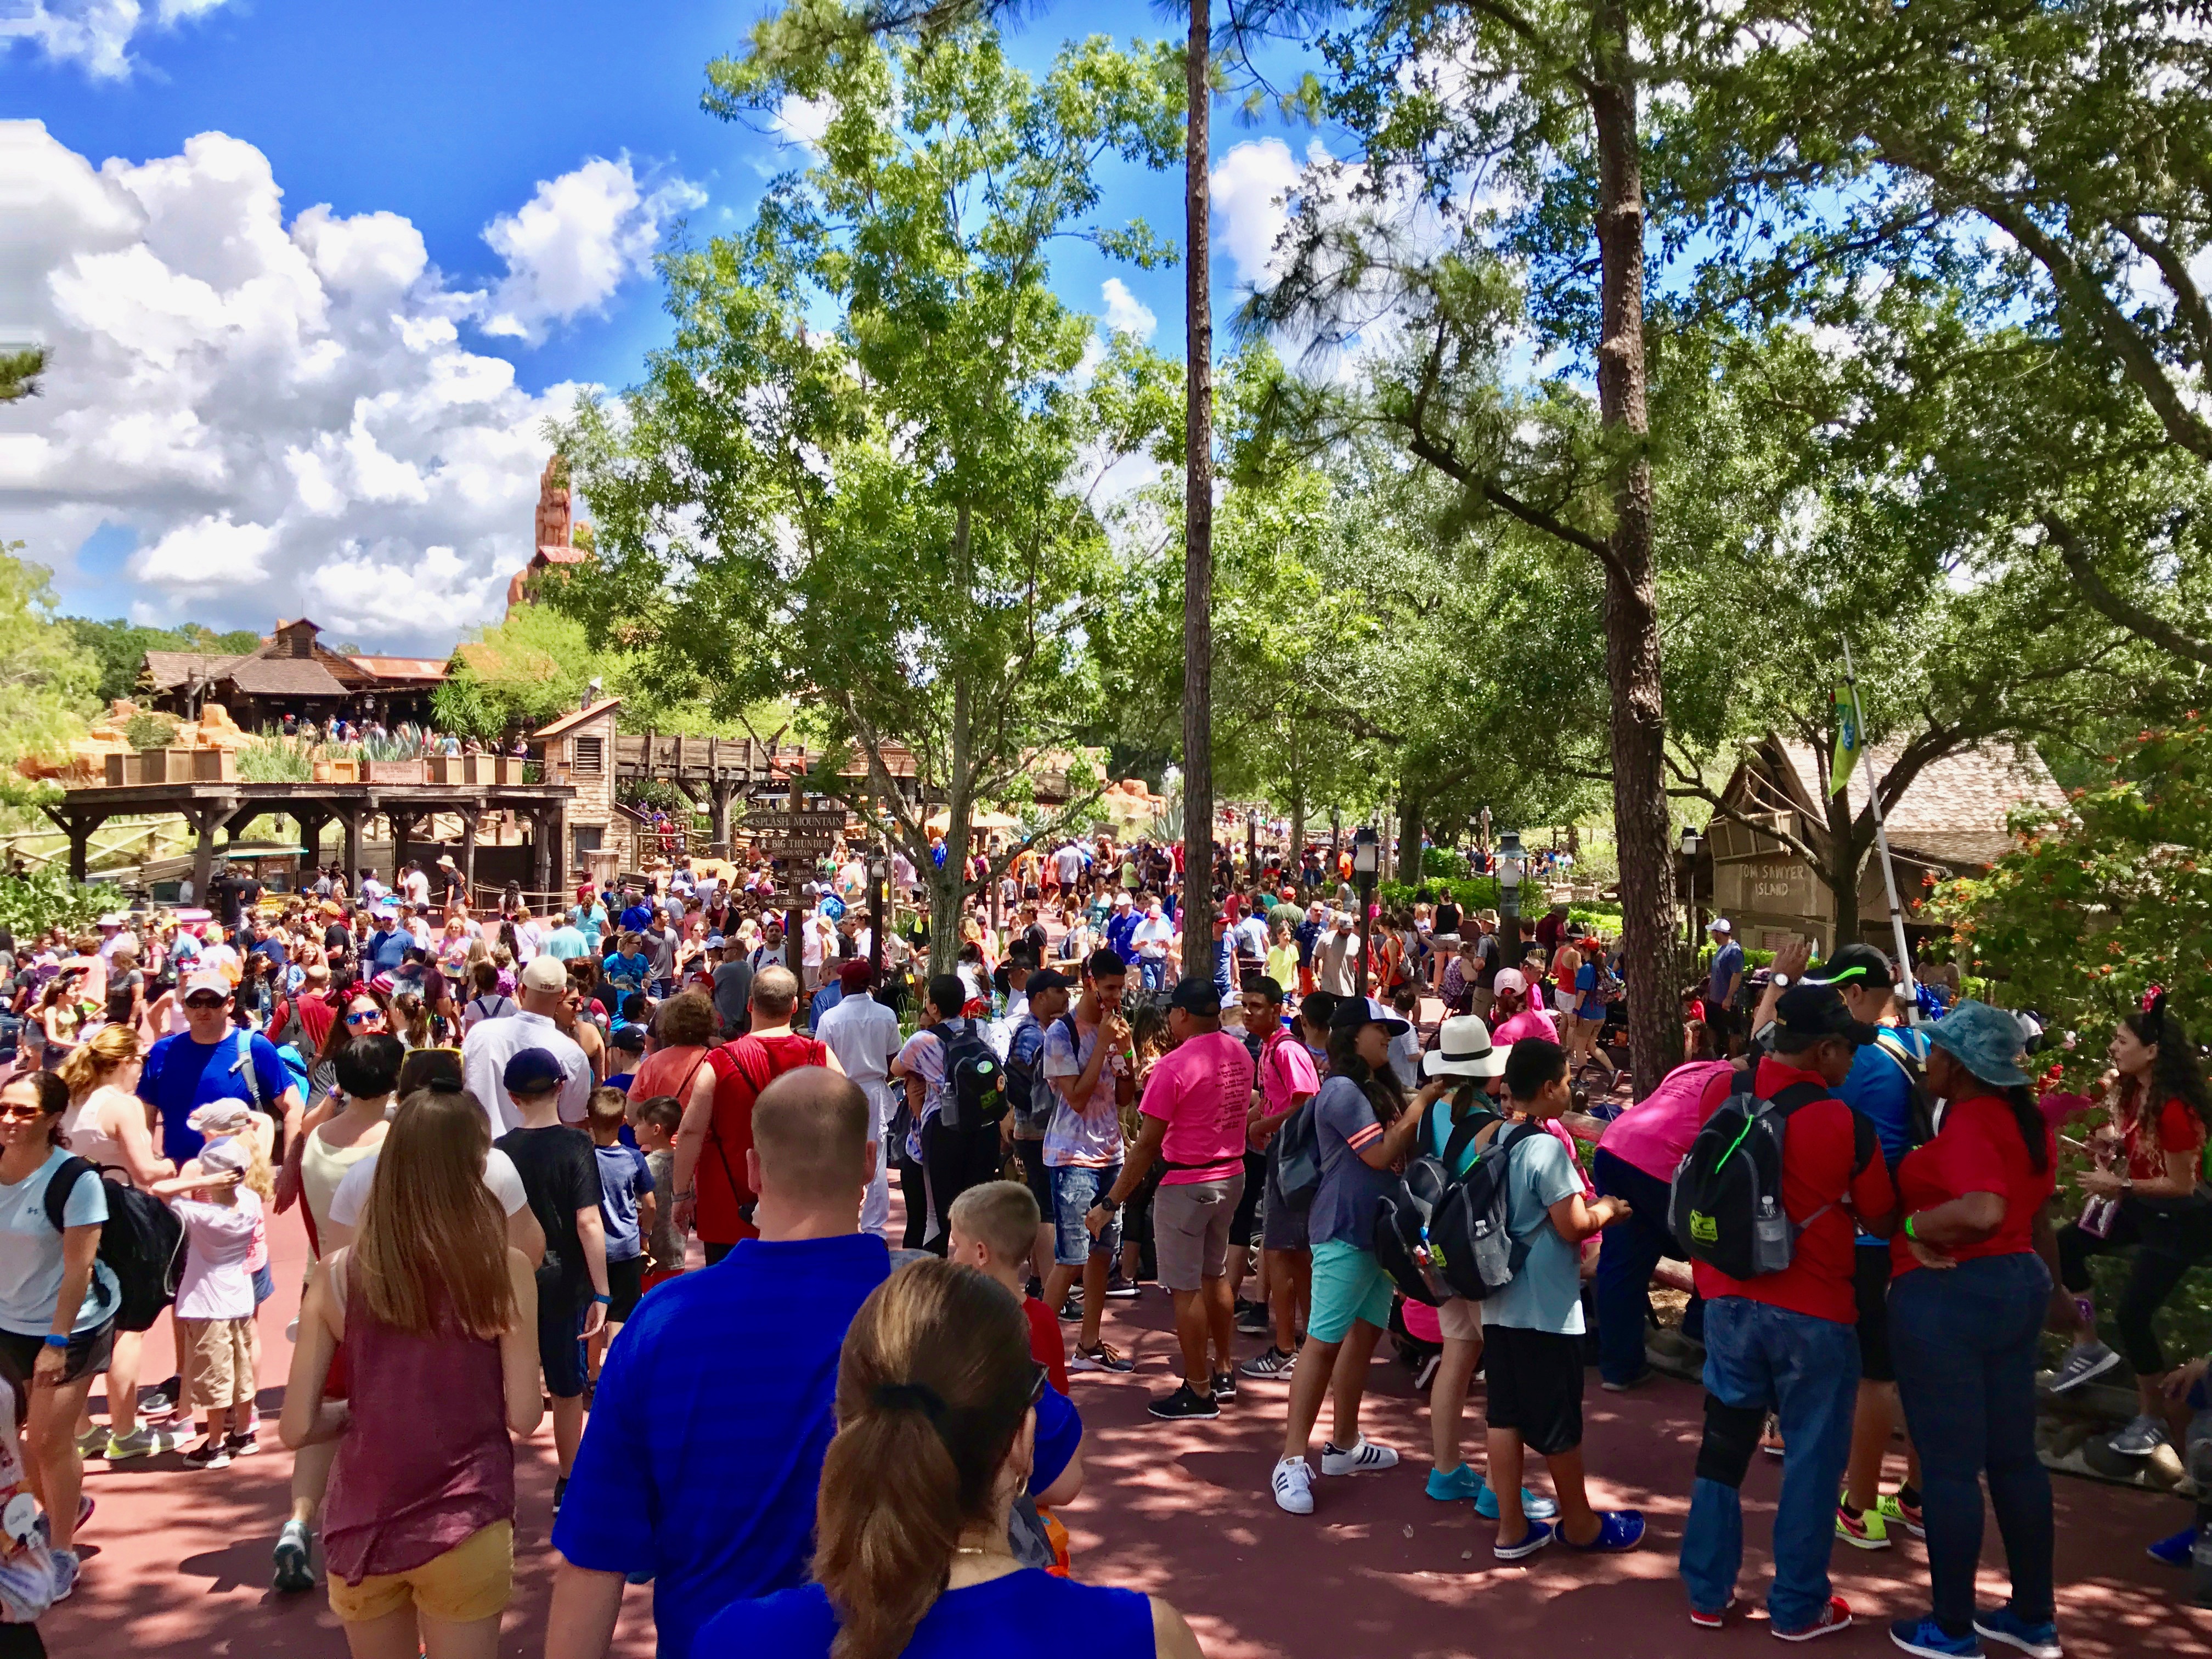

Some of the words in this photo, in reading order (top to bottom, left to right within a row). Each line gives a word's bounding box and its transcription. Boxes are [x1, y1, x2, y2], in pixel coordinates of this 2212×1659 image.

[883, 753, 917, 763] MOUNTA
[755, 817, 788, 826] SPLASH
[793, 816, 842, 826] MOUNTAIN
[771, 839, 786, 848] BIG
[788, 839, 830, 848] THUNDER
[1738, 864, 1758, 878] TOM
[1762, 865, 1804, 879] SAWYER
[1755, 882, 1788, 896] ISLAND
